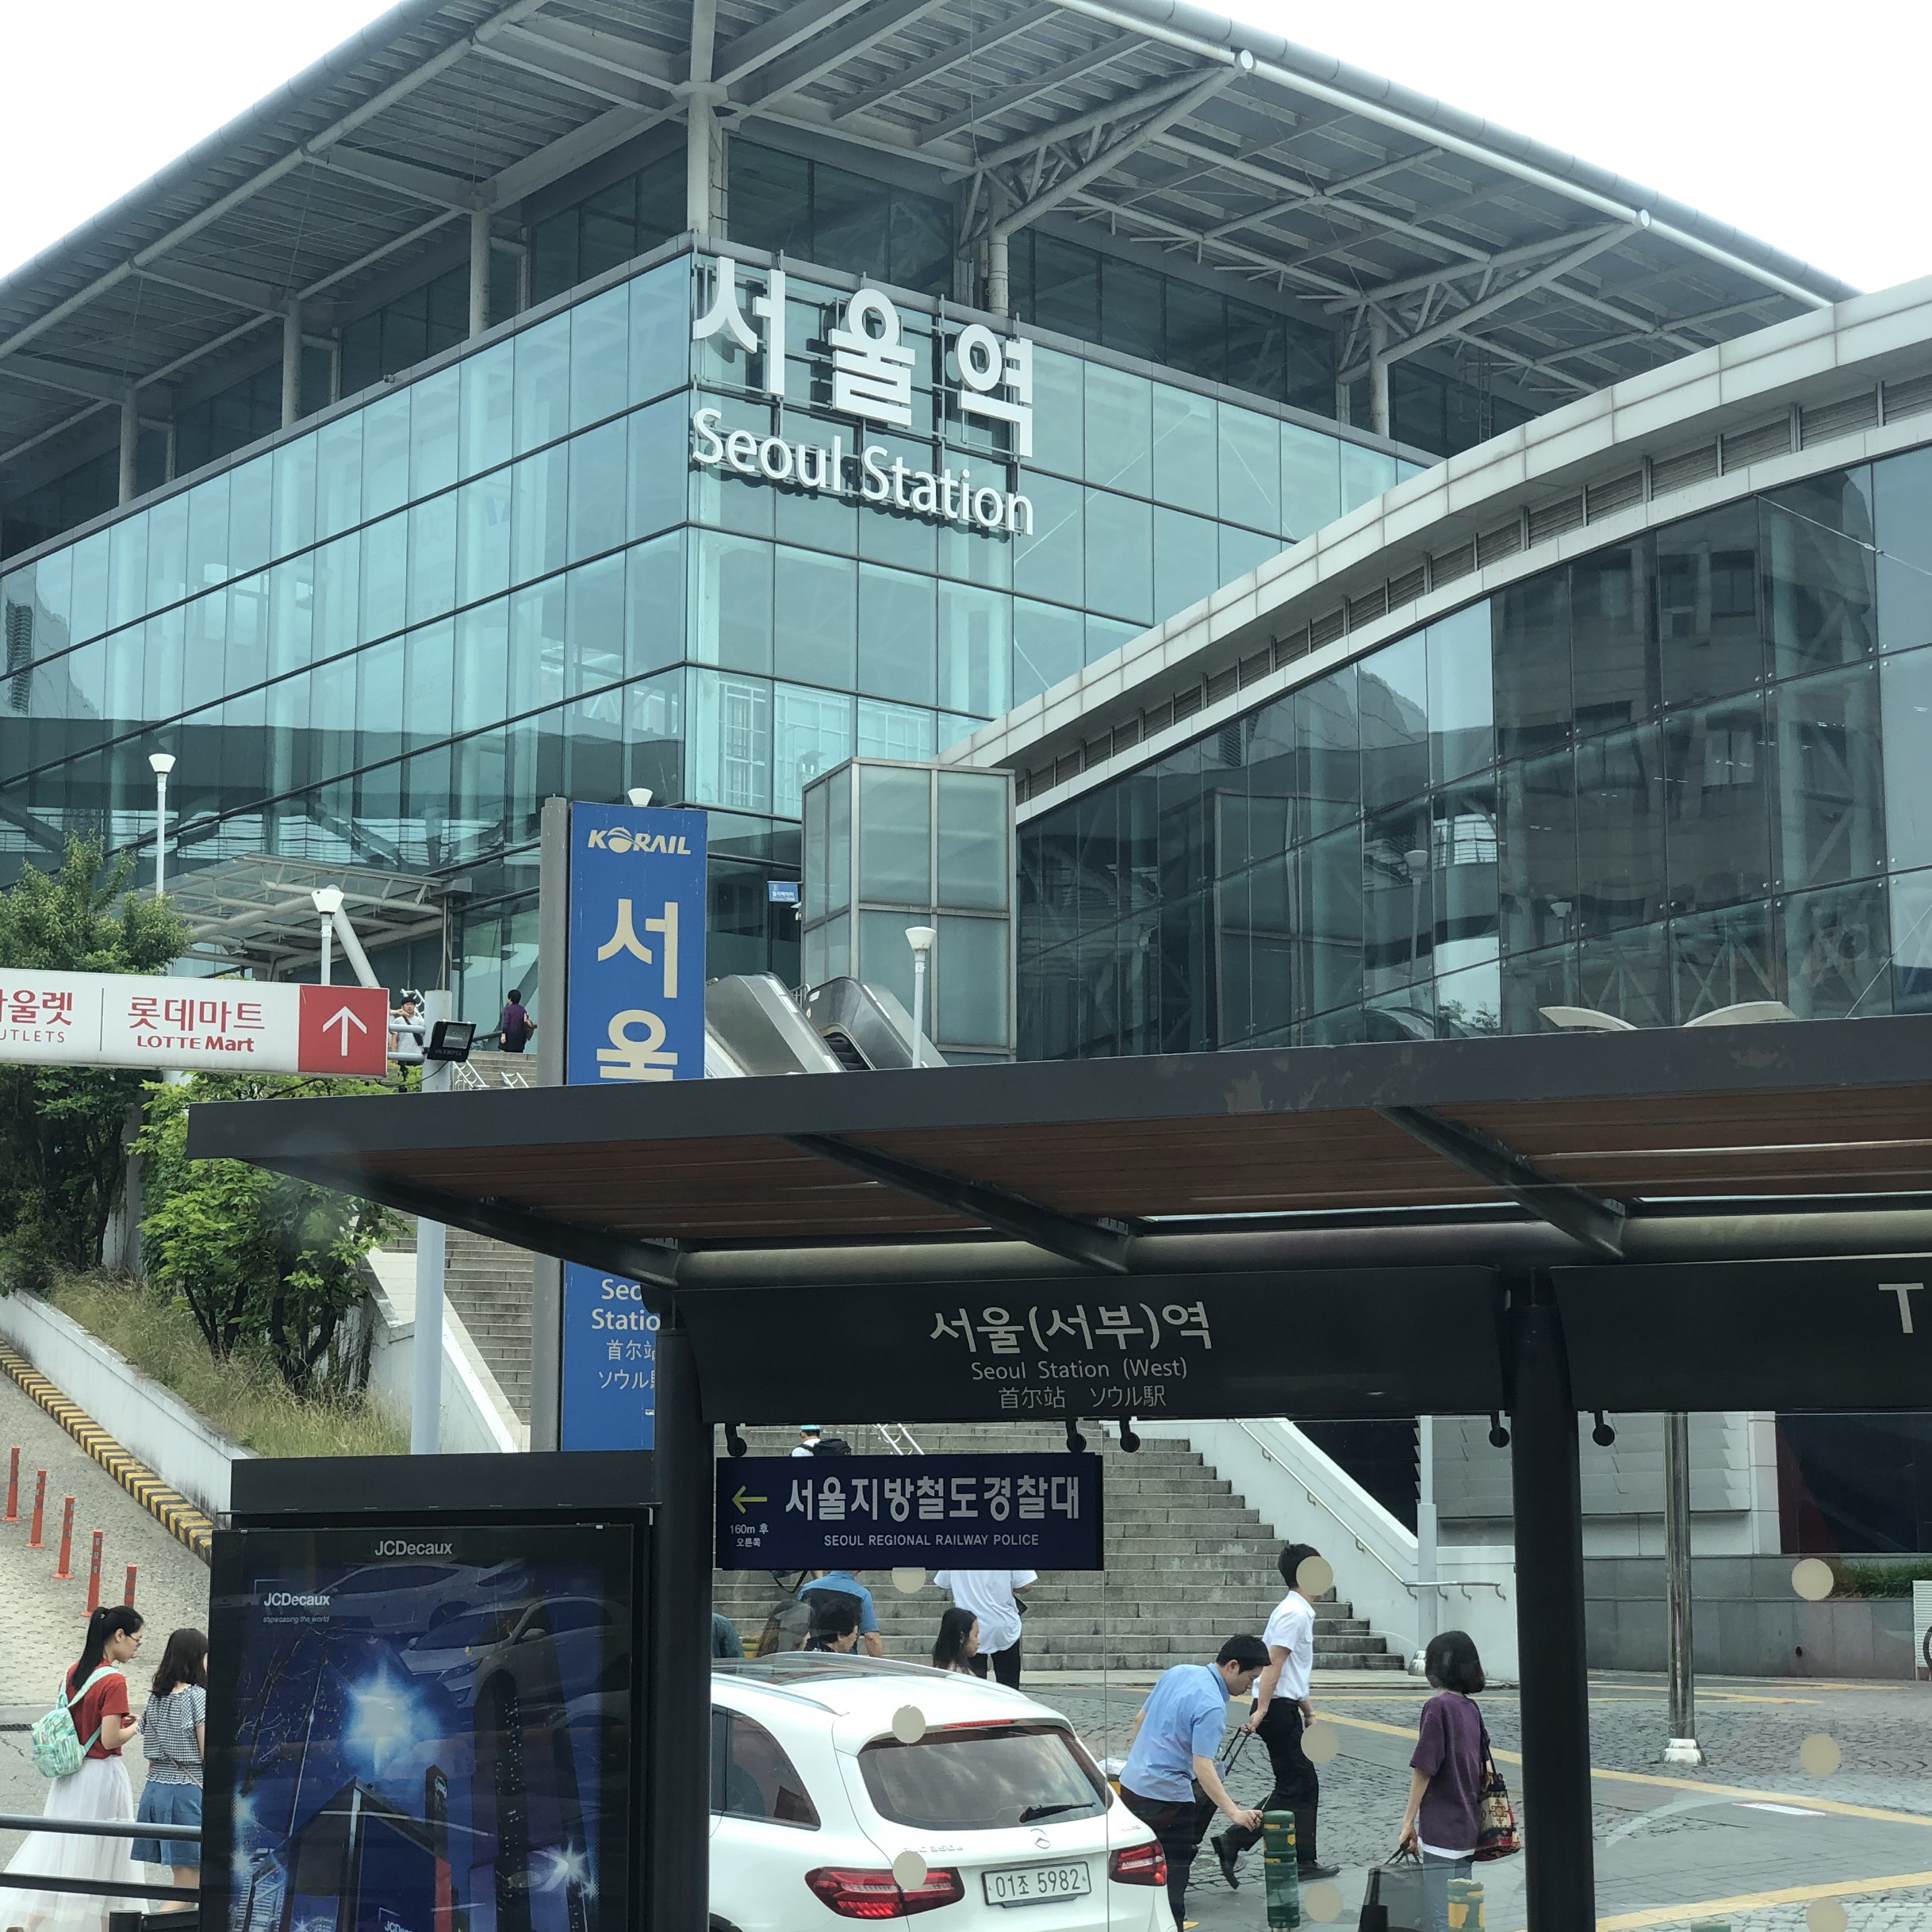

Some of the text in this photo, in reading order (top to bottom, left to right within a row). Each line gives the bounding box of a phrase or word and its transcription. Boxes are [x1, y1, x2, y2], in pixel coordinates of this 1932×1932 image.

[692, 255, 1033, 458] 서울역
[692, 407, 1033, 536] Seoul Station
[588, 826, 692, 855] KORAIL
[128, 996, 266, 1033] 롯데마트
[136, 1035, 255, 1052] LOTTE Mart
[1878, 1282, 1924, 1334] T
[930, 1301, 1213, 1354] 서울(서부)역
[971, 1356, 1188, 1380] Seoul Station (West)
[999, 1385, 1167, 1409] 首尔站 ソウル駅
[785, 1474, 1079, 1522] 서울지방철도경찰대
[730, 1523, 769, 1535] 160m 후
[736, 1537, 761, 1547] 오른쪽
[824, 1534, 1040, 1547] SEOUL REGIONAL RAILWAY POLICE
[374, 1539, 453, 1556] JCDecaux
[263, 1592, 331, 1607] JCDecaux
[995, 1869, 1081, 1898] 01조 5982
